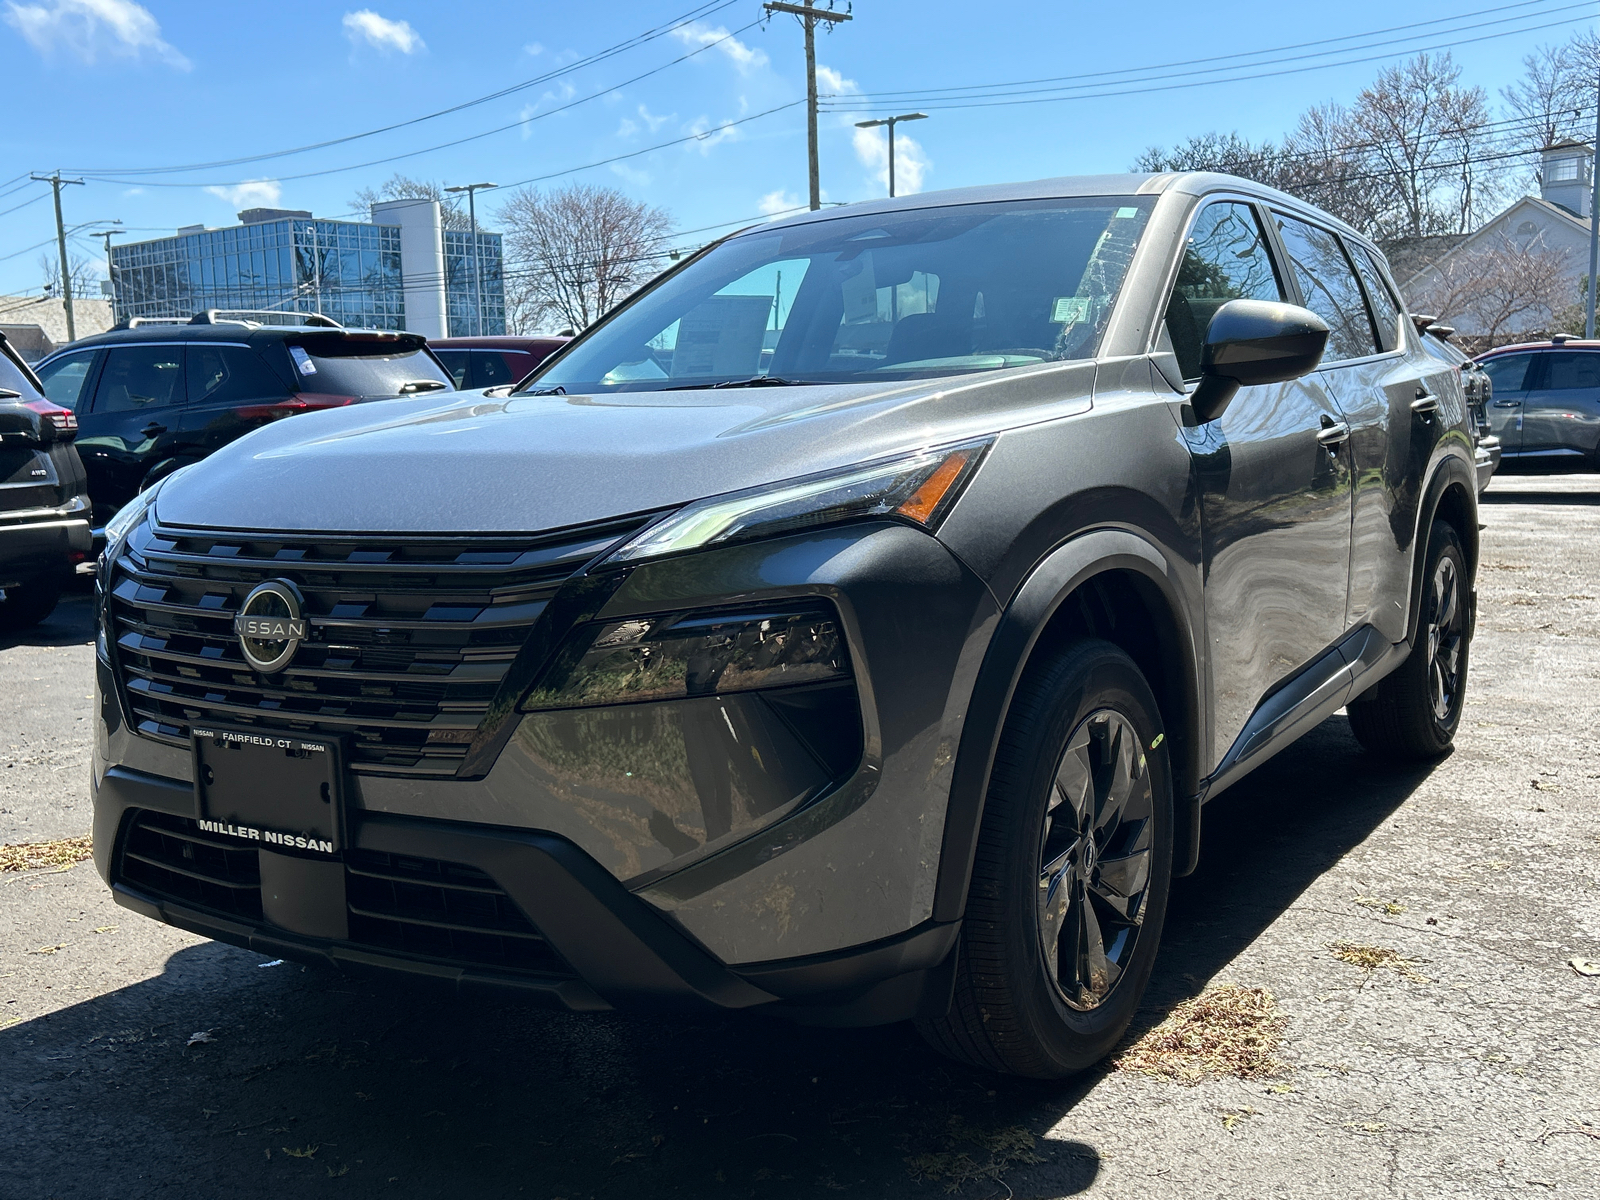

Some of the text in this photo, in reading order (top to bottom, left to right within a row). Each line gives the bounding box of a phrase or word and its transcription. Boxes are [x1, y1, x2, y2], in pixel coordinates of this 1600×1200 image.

[235, 618, 303, 636] NISSAN
[193, 729, 214, 738] NISSAN
[222, 732, 292, 749] FAIRFIELD, CT
[301, 743, 325, 752] NISSAN
[199, 819, 333, 854] MILLER NISSAN
